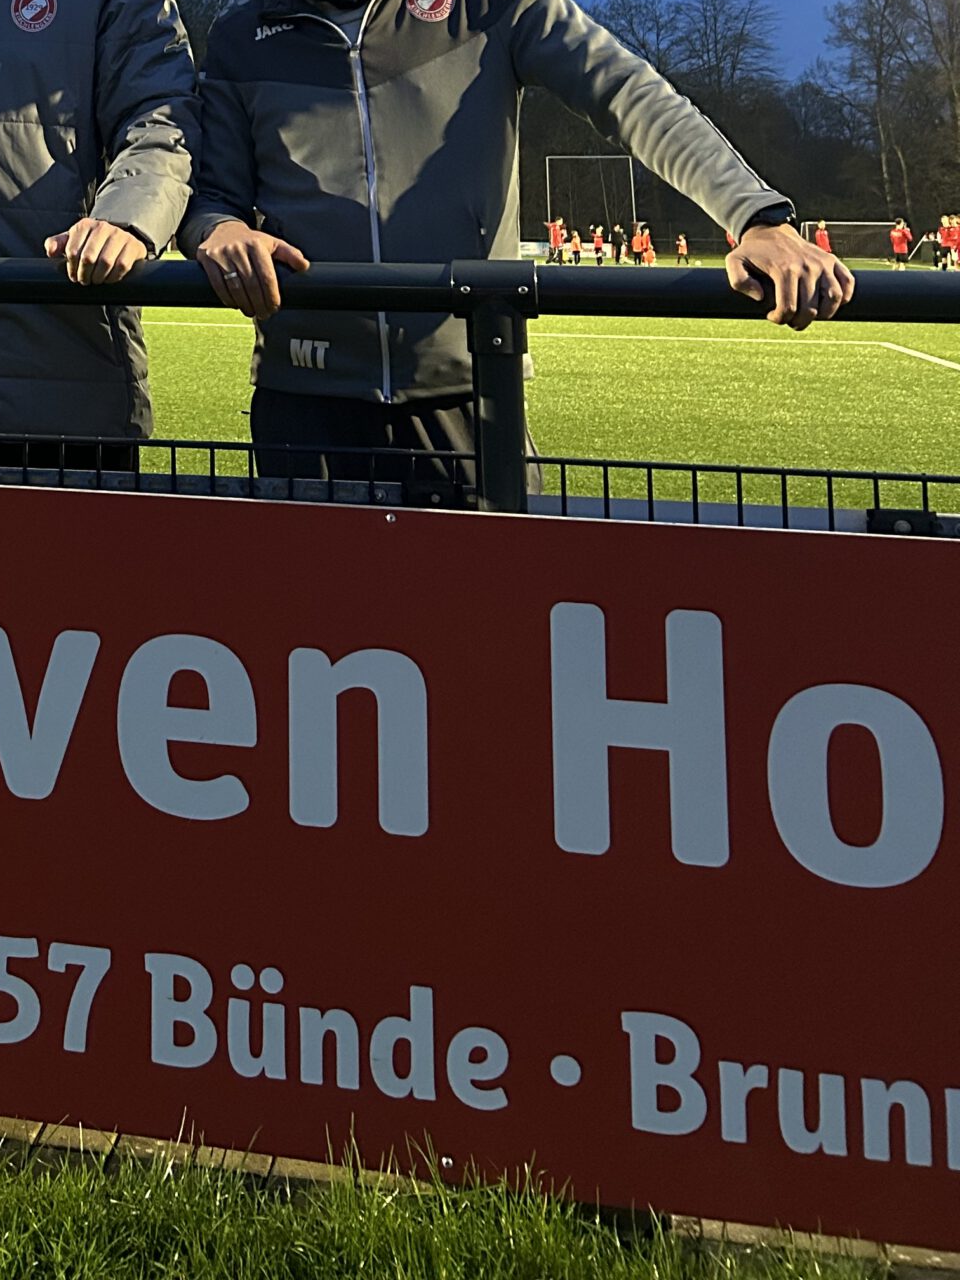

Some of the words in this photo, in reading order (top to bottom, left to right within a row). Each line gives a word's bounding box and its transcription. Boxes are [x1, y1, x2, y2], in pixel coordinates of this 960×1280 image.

[290, 338, 330, 369] MT
[551, 602, 944, 889] Ho
[144, 952, 509, 1111] Bünde
[621, 1011, 960, 1170] Brun
